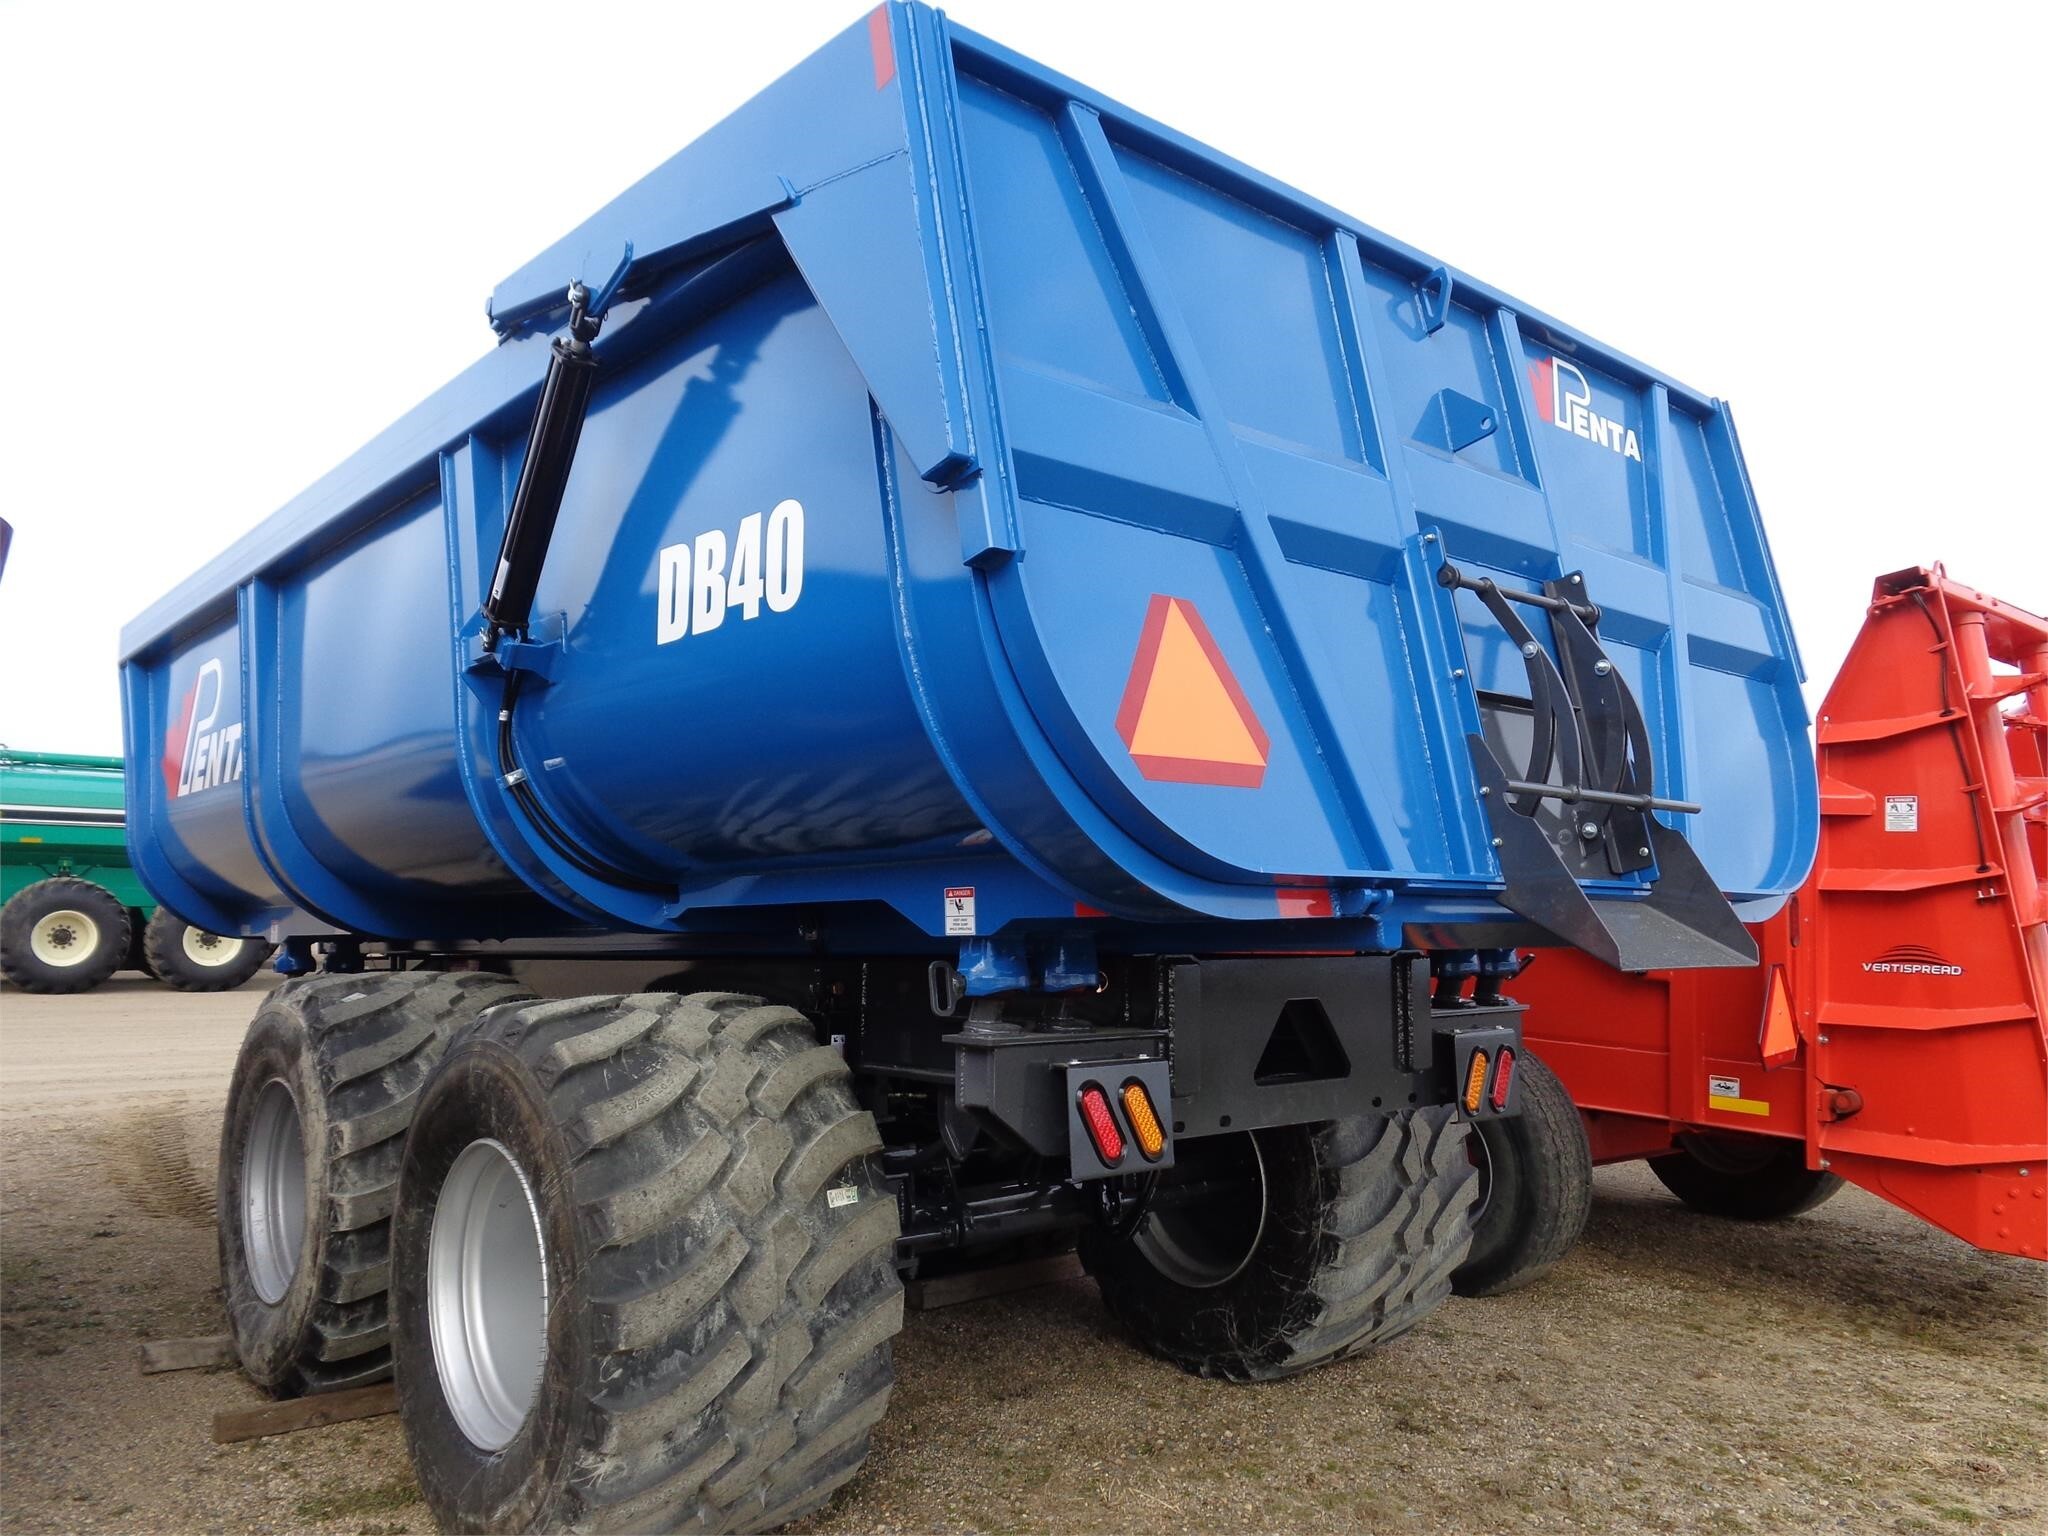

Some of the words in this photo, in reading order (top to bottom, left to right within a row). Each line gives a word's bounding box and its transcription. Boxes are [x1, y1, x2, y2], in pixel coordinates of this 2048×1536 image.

[1552, 356, 1641, 462] PENTA
[657, 499, 804, 645] DB40
[1862, 963, 1962, 975] VERTISPREAD
